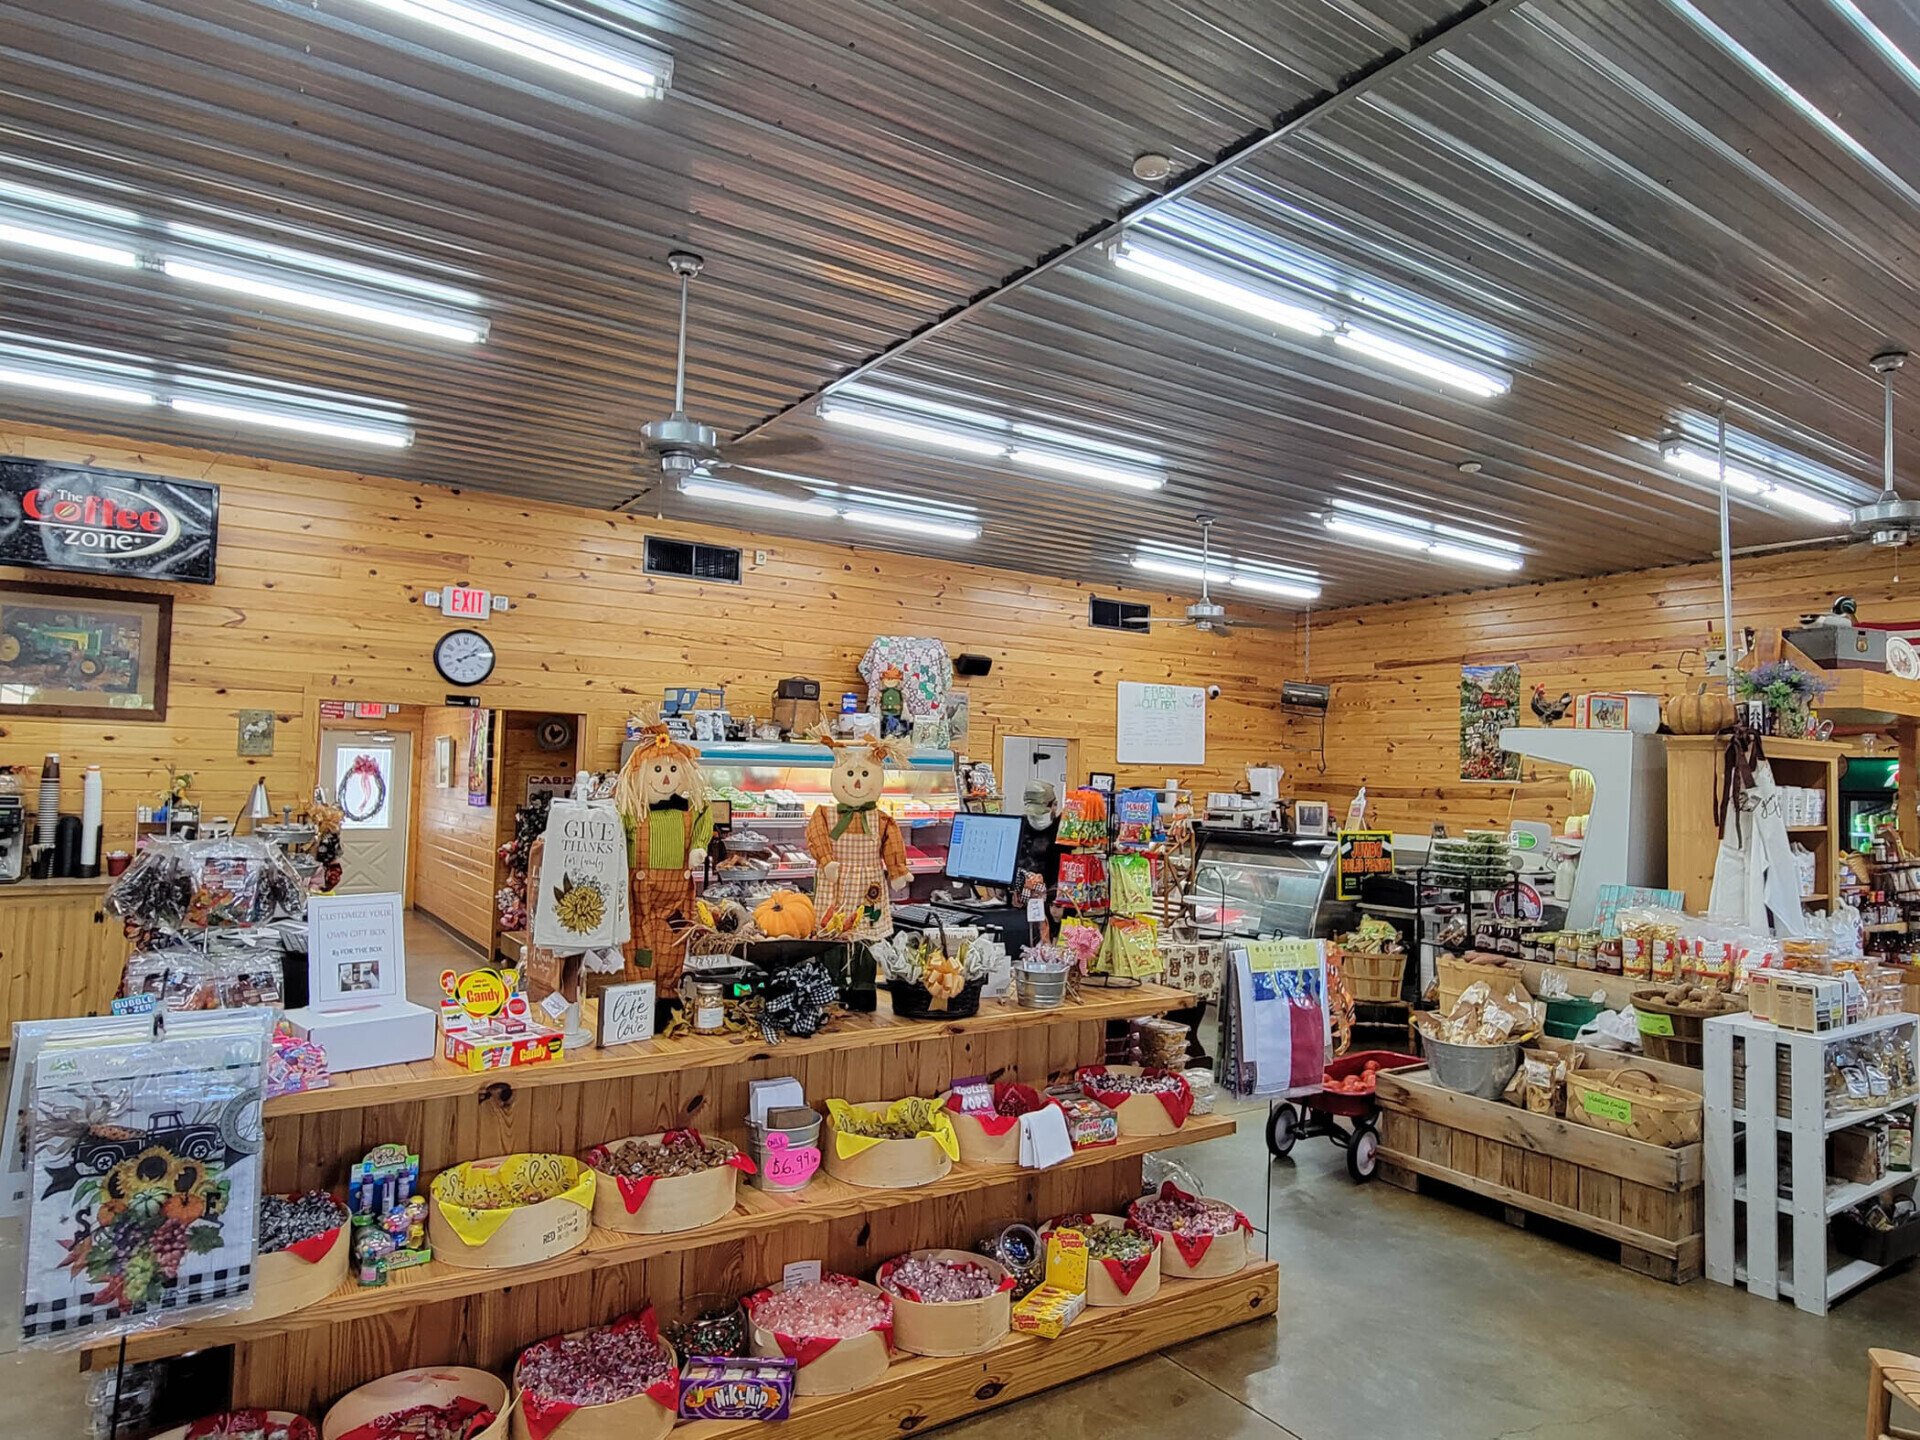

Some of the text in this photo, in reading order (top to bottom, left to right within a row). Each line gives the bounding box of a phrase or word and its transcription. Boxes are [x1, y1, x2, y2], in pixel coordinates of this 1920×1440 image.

[57, 489, 84, 503] The
[22, 488, 162, 531] Coffee
[451, 589, 485, 613] EXIT
[529, 776, 573, 785] CASE
[563, 819, 615, 842] GIVE
[561, 839, 614, 854] THANKS
[1351, 841, 1383, 858] JUMBO
[1255, 944, 1307, 953] evergreen
[466, 988, 500, 1003] Candy
[613, 994, 649, 1022] life
[617, 1018, 647, 1039] love
[520, 1044, 546, 1060] Candy
[962, 1095, 989, 1110] POPS
